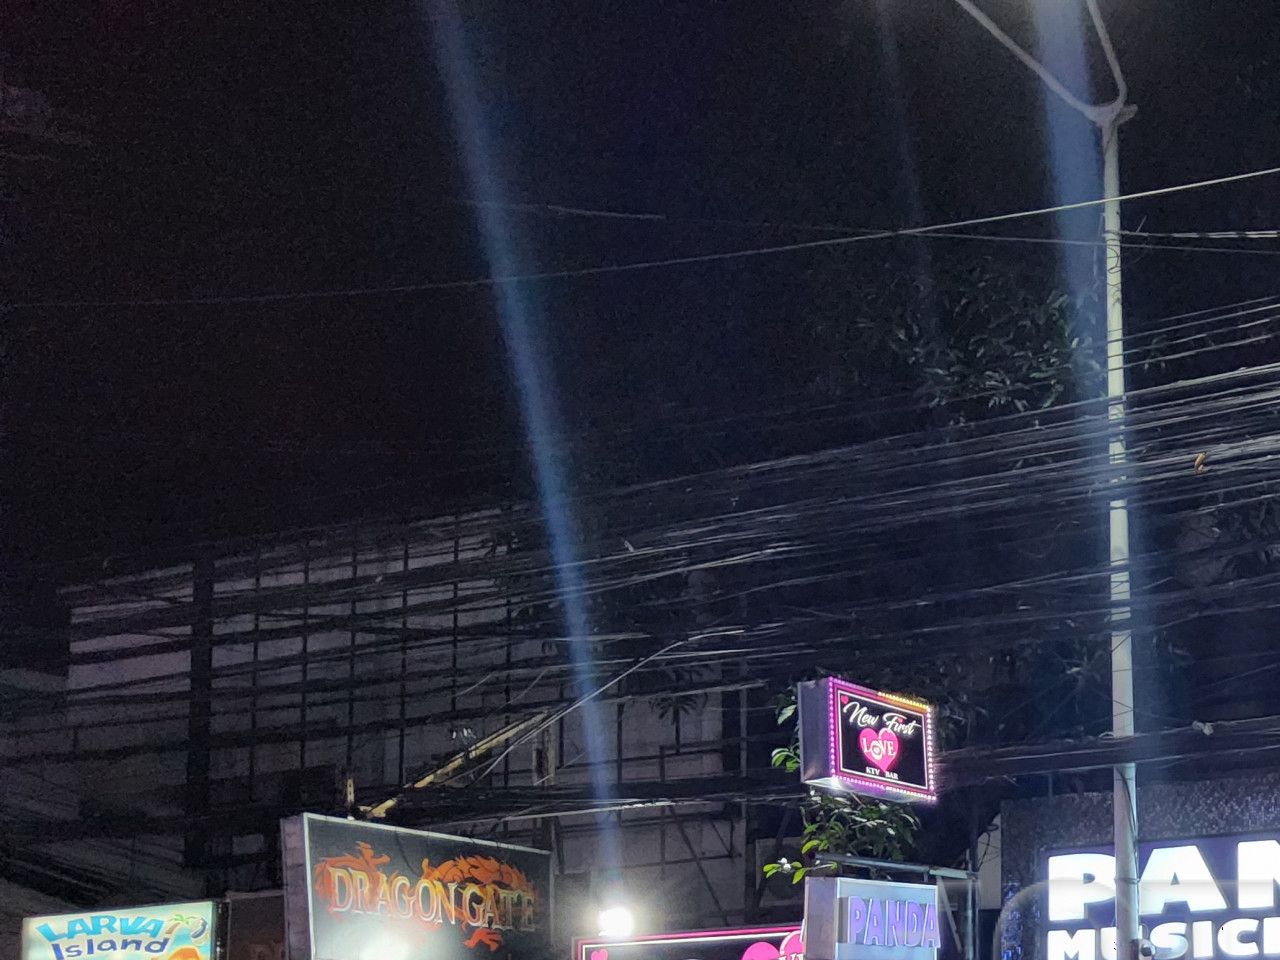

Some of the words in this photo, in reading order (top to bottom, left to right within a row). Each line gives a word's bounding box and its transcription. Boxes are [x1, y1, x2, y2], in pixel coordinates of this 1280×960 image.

[843, 701, 880, 726] New
[882, 712, 921, 736] First
[863, 738, 895, 760] LOVE
[866, 766, 880, 776] KTV
[885, 771, 898, 780] BAR
[330, 865, 458, 926] DRAGON
[463, 885, 536, 931] GATE
[36, 914, 164, 941] LARVA
[848, 896, 941, 948] PANDA
[51, 938, 170, 960] Island
